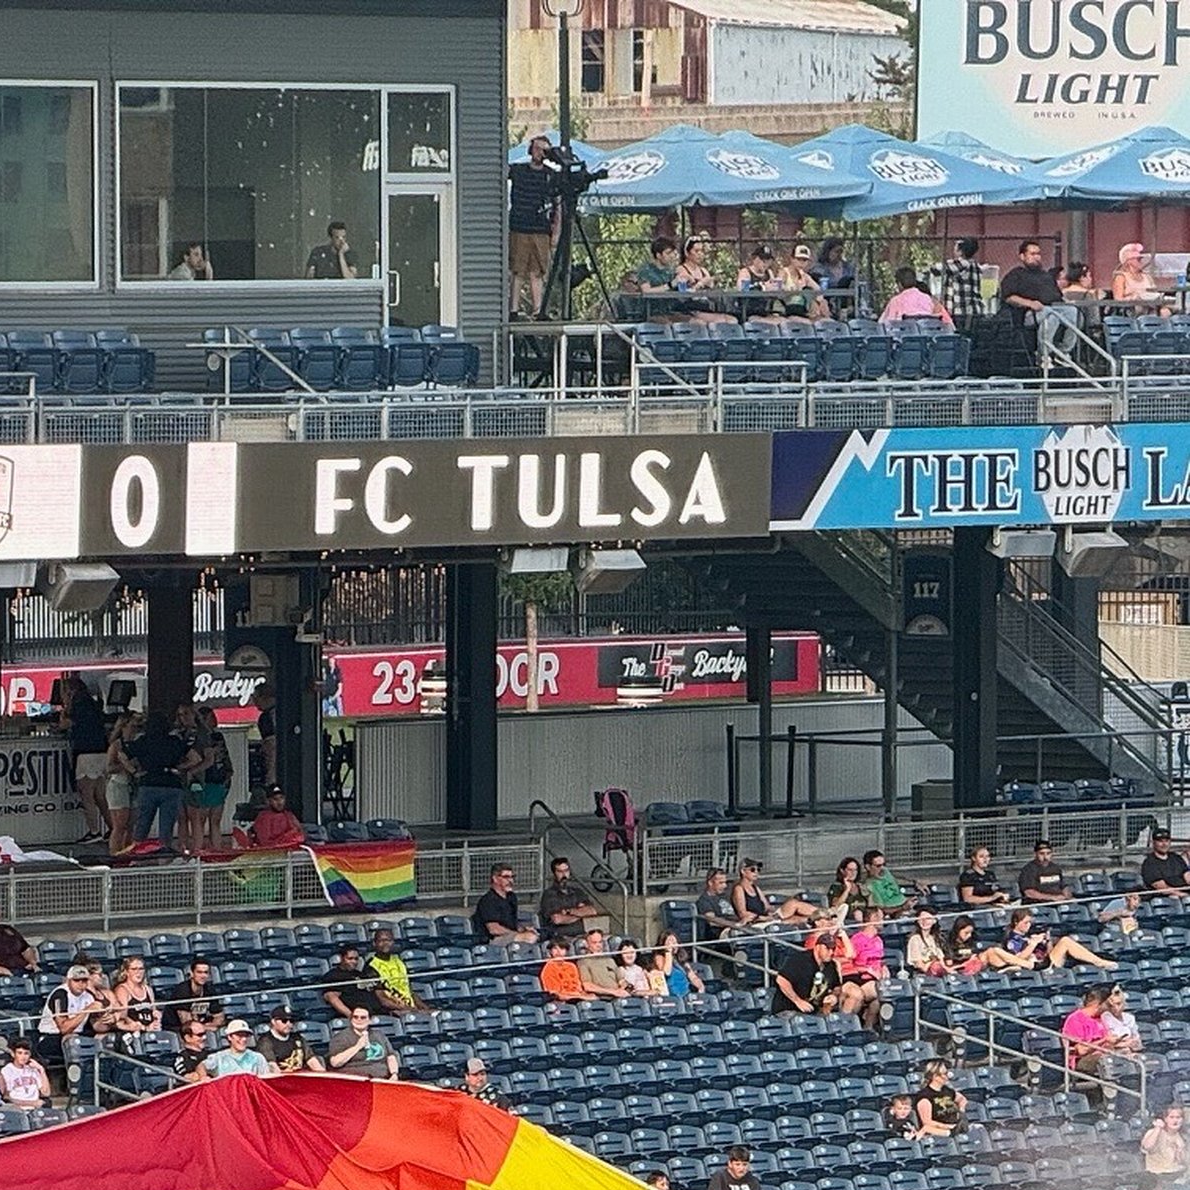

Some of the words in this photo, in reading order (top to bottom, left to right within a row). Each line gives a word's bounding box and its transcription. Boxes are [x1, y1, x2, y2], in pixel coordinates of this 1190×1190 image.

[1015, 73, 1159, 104] LIGHT
[872, 160, 946, 178] BUSCH
[1142, 160, 1190, 173] BUS
[887, 449, 1021, 521] THE
[1033, 447, 1130, 492] BUSCH
[110, 455, 161, 548] 0
[314, 455, 413, 534] FC
[457, 451, 726, 529] TULSA
[1054, 495, 1111, 516] LIGHT
[913, 582, 940, 598] 117
[622, 657, 646, 677] The
[193, 671, 266, 706] Backy
